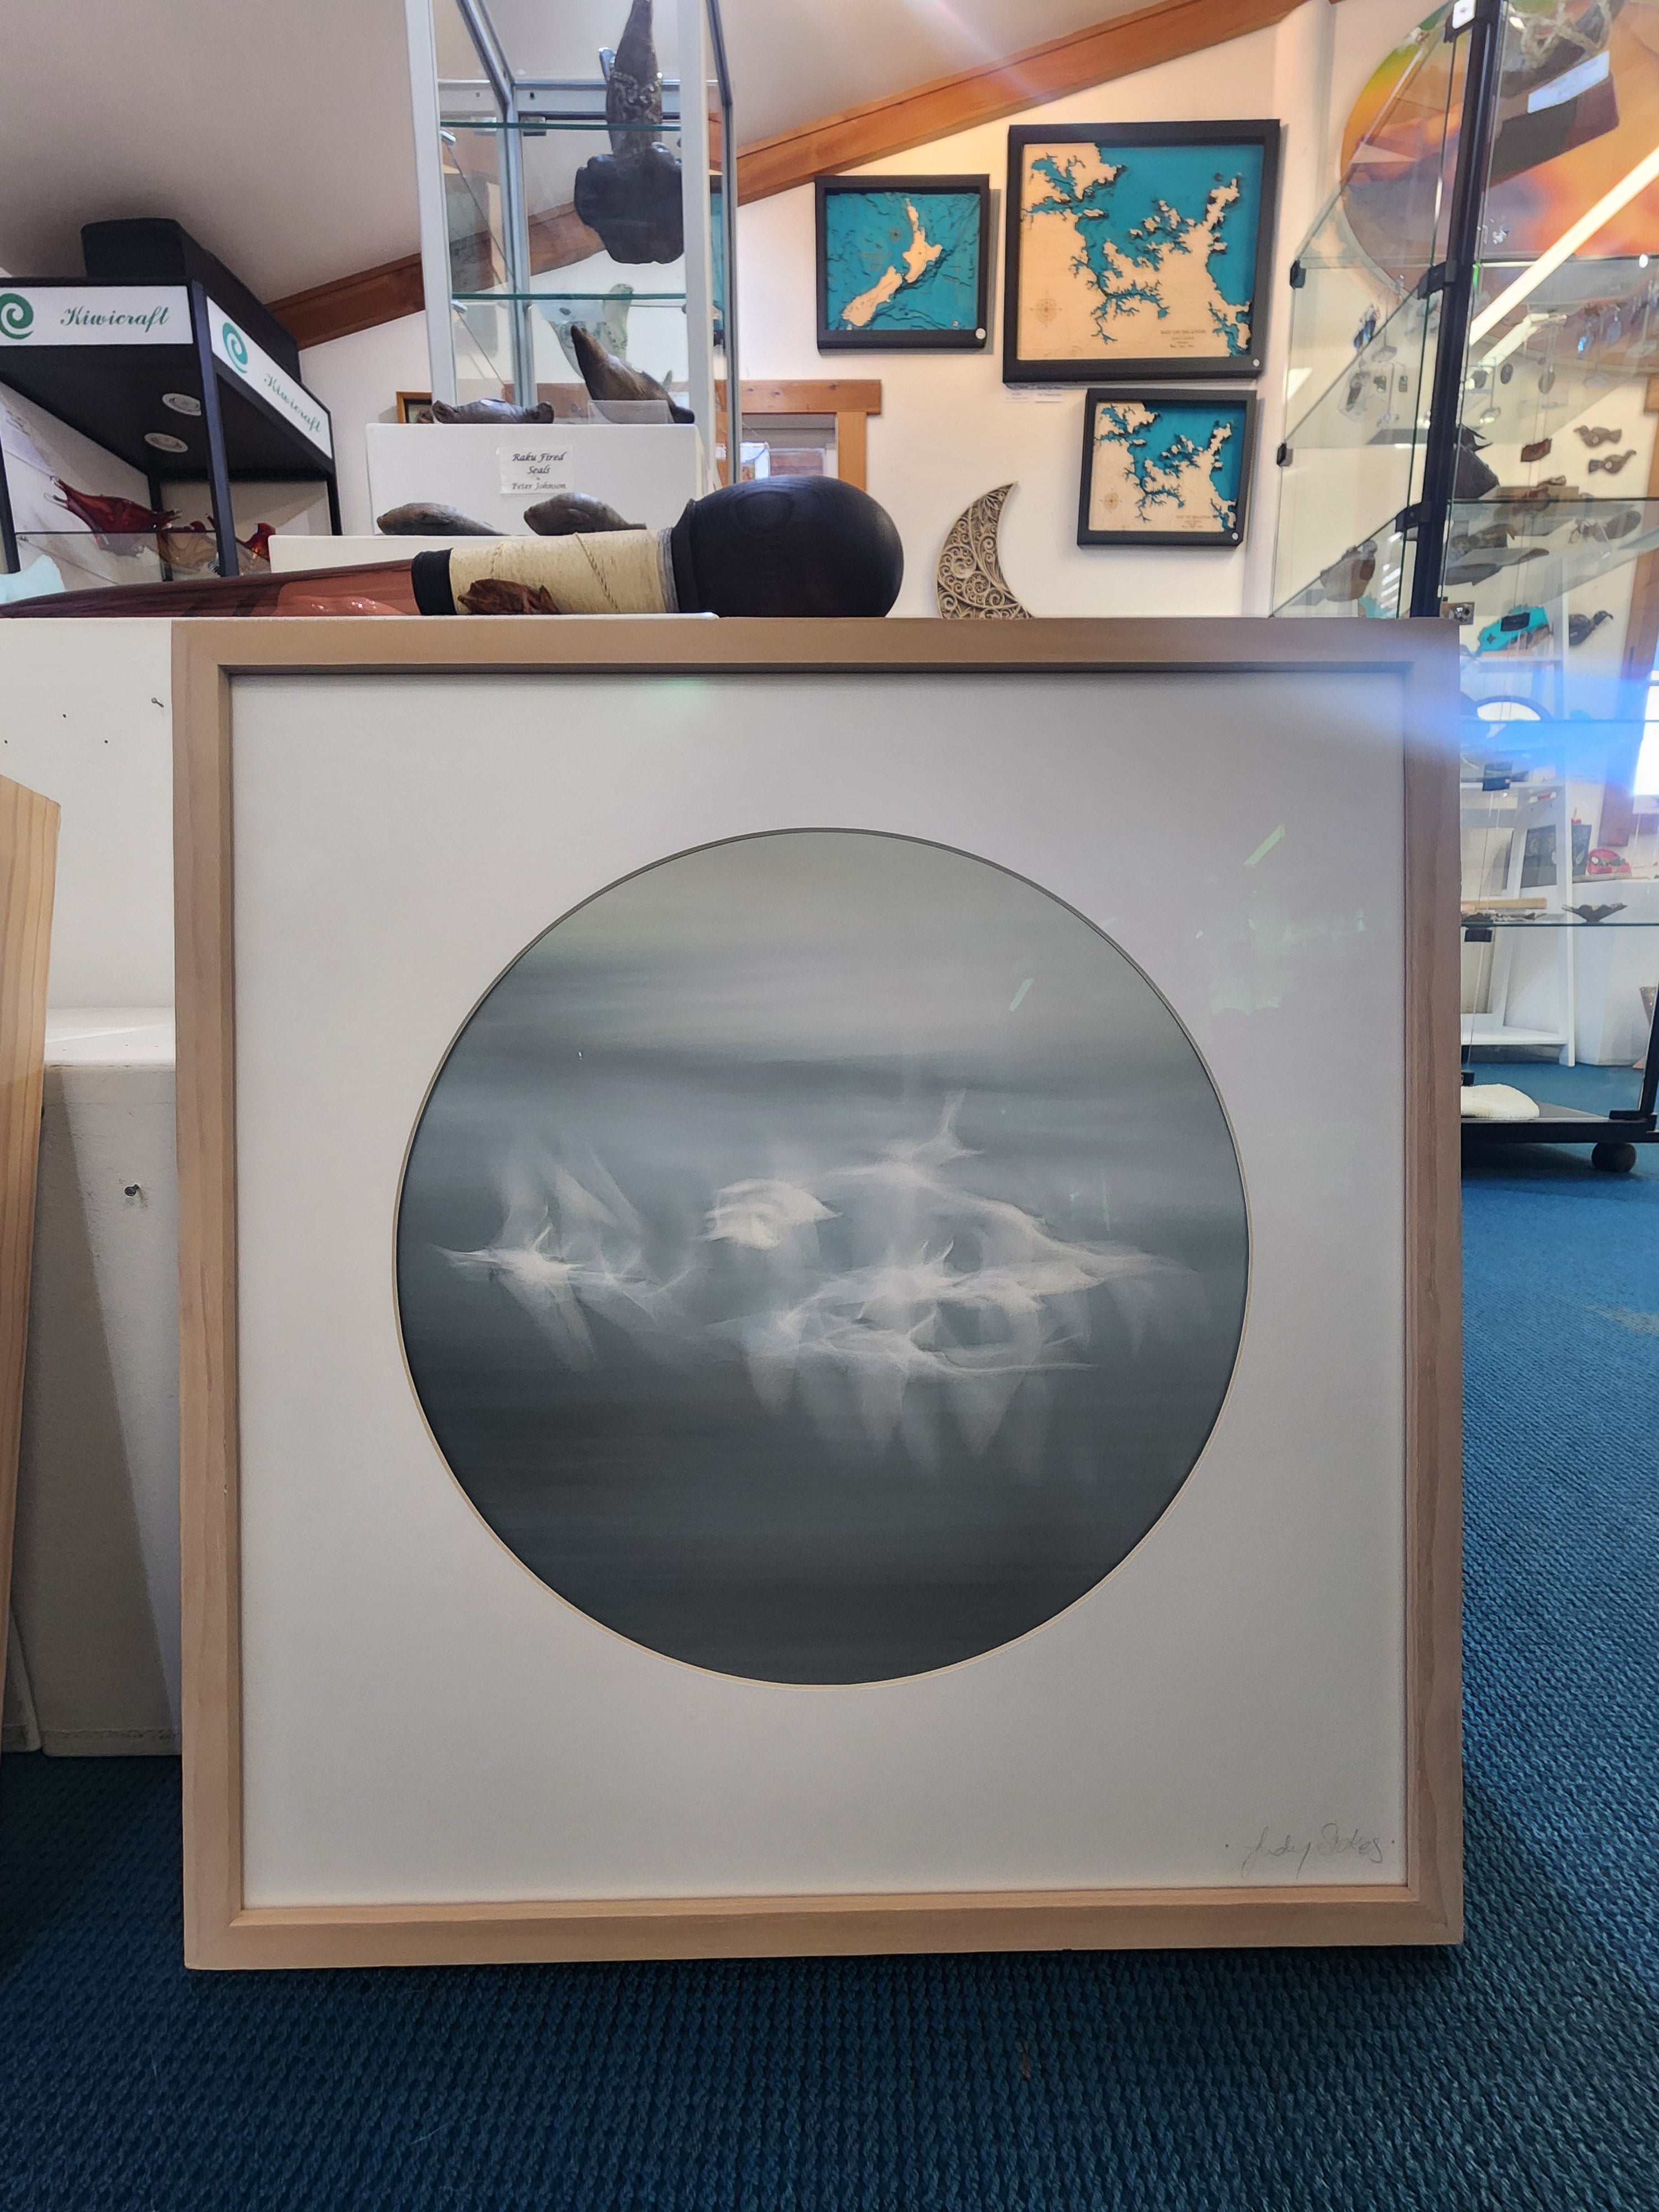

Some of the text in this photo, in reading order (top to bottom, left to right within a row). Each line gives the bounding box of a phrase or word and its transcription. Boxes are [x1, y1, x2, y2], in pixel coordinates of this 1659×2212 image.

[60, 305, 169, 333] Kiwicraft
[264, 373, 321, 432] Kiwicraft
[512, 451, 568, 463] Raku Fired
[527, 465, 551, 474] Seals
[534, 482, 566, 491] Johnson
